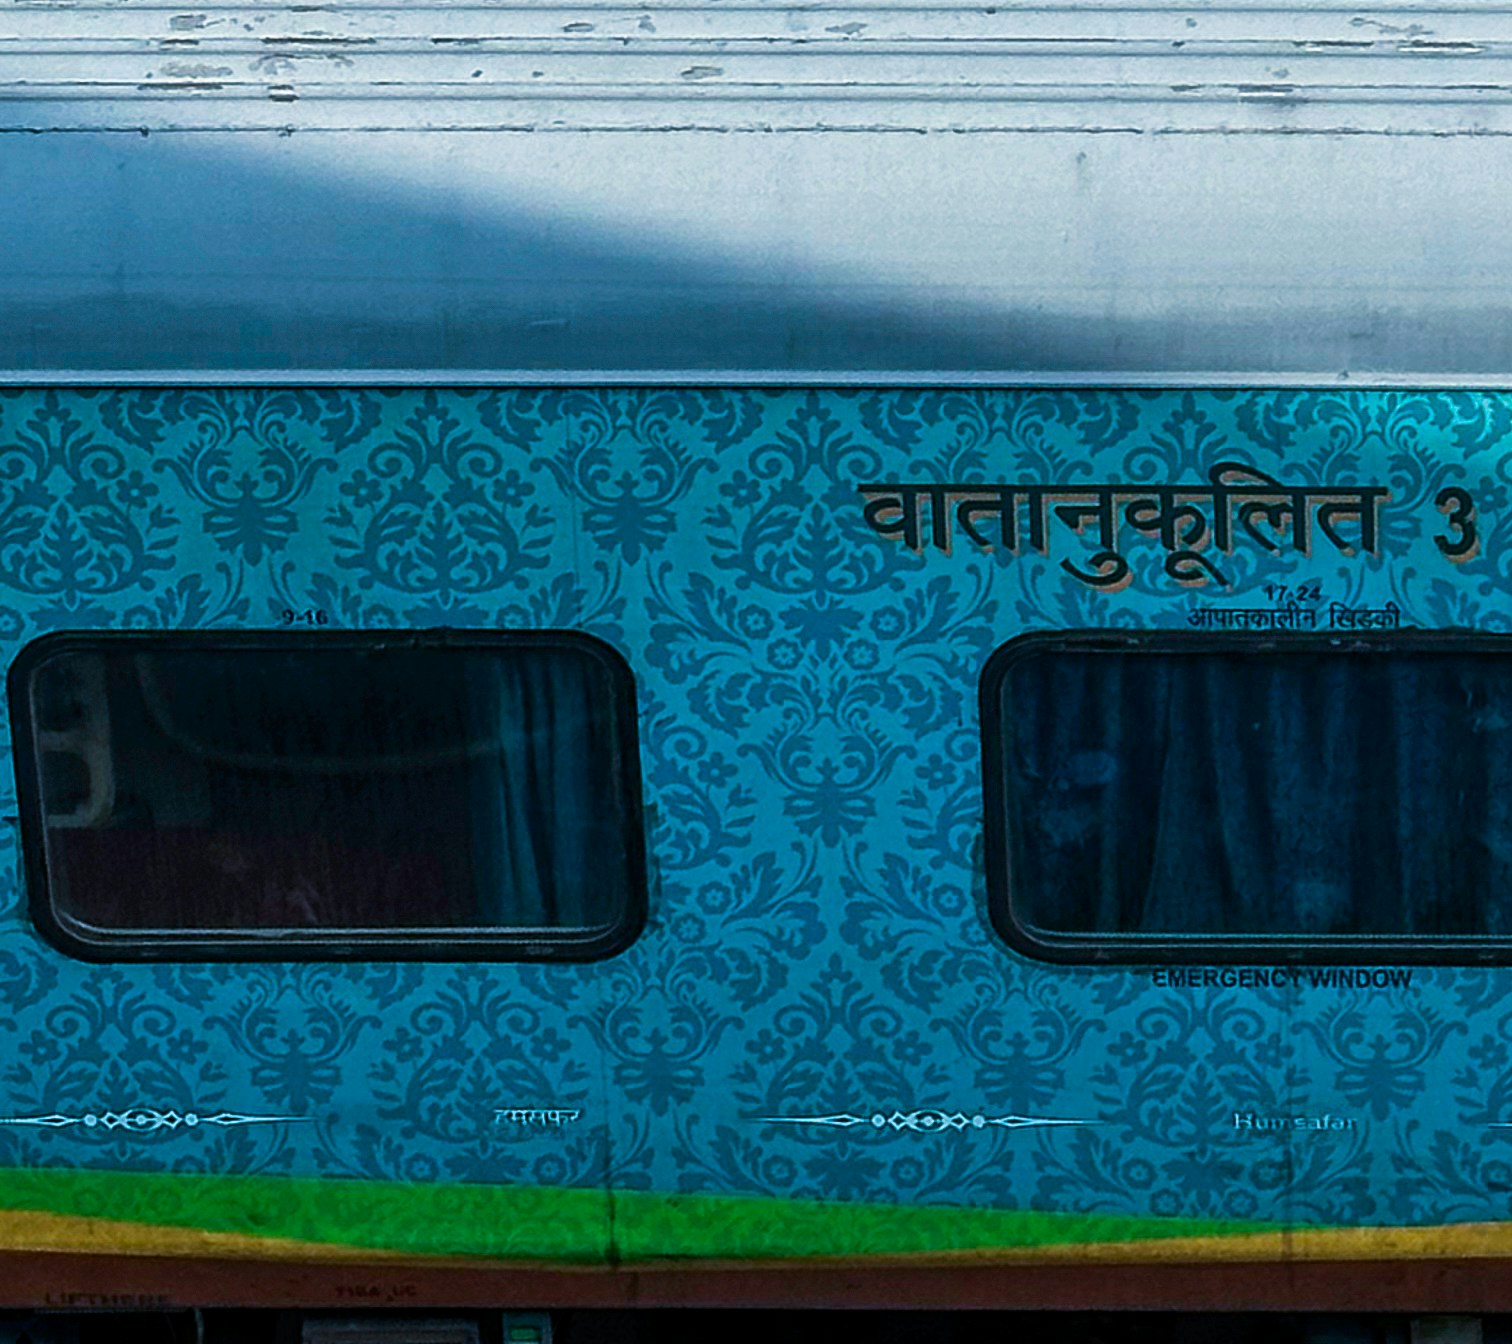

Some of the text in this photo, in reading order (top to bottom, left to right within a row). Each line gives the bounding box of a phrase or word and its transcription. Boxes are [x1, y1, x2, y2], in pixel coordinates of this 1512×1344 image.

[857, 461, 1391, 591] वातानुकूलित
[1432, 484, 1479, 562] 3
[1151, 968, 1413, 989] EMERGENCY WINDOW
